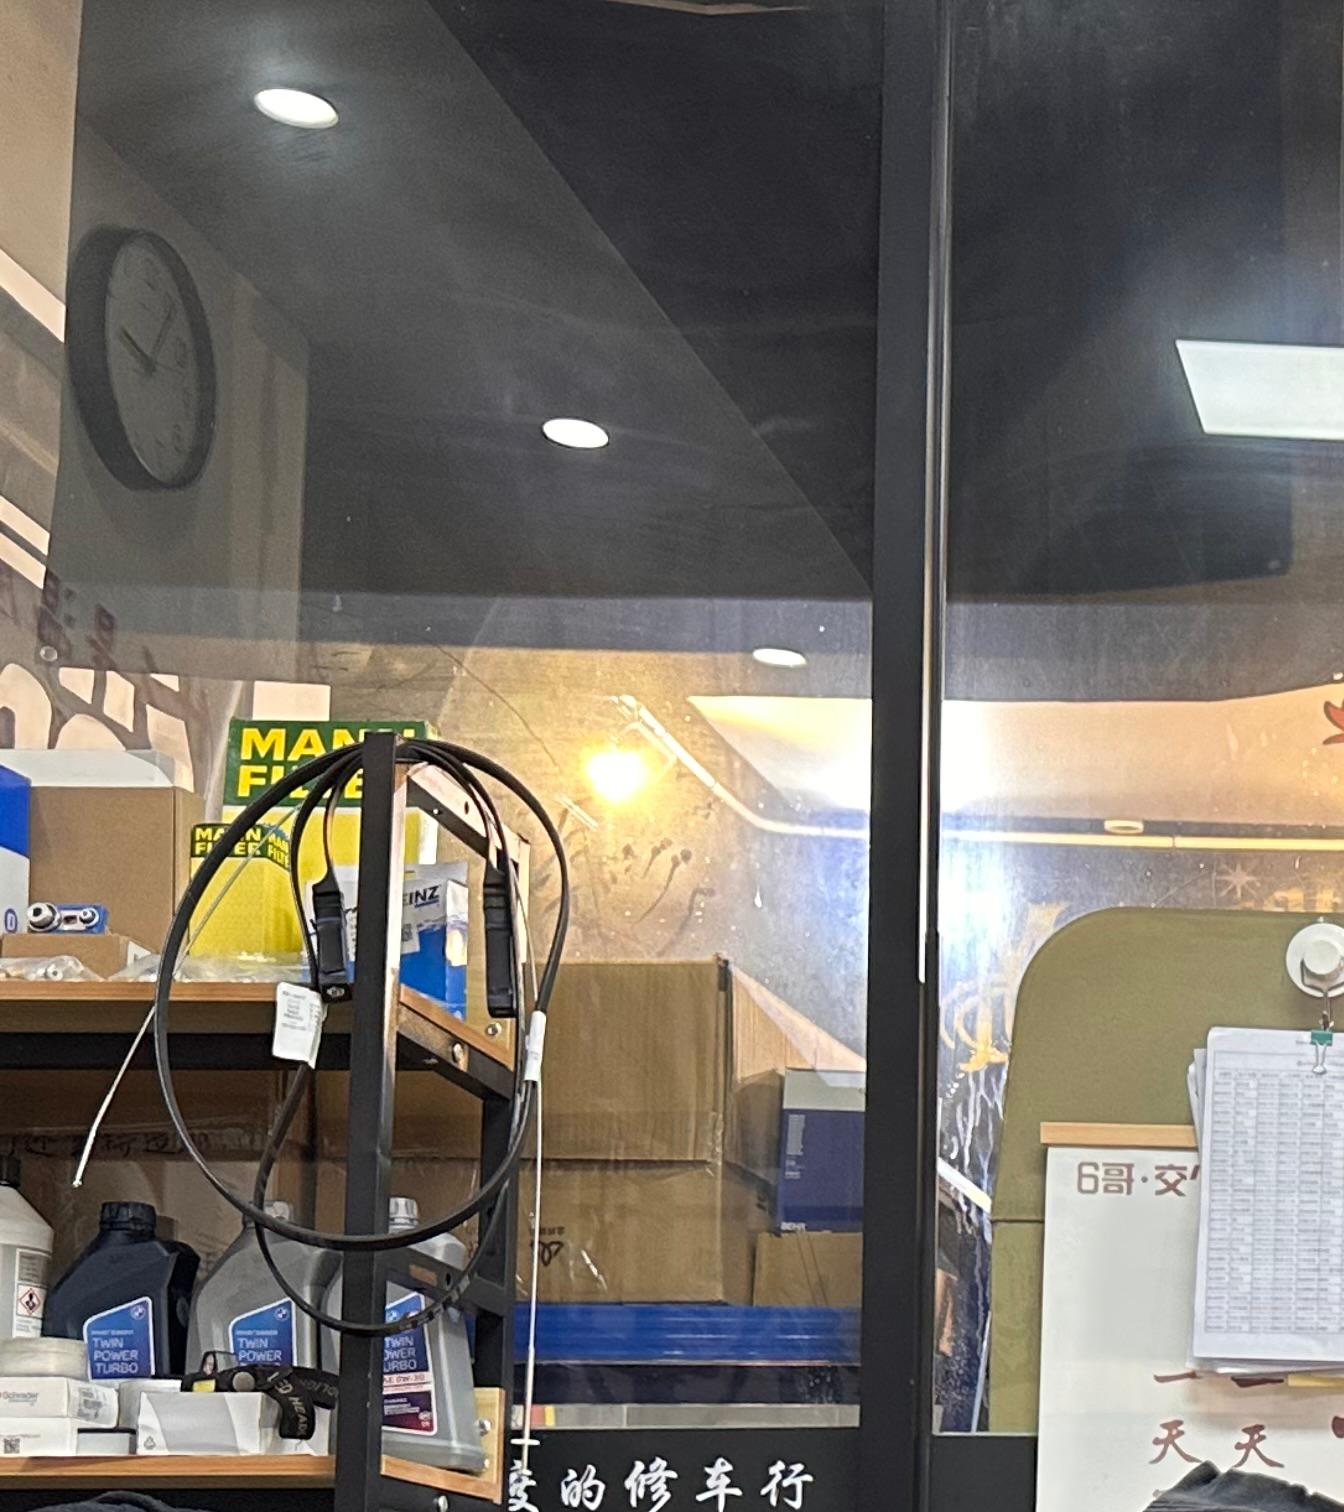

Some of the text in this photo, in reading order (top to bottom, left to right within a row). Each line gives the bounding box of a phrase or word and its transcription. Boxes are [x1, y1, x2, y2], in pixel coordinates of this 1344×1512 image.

[1077, 1160, 1200, 1198] 6哥·交
[93, 1337, 124, 1348] TWIN
[238, 1337, 269, 1348] TWIN
[93, 1350, 139, 1362] POWER
[238, 1350, 282, 1362] POWER
[94, 1362, 139, 1375] TURBO
